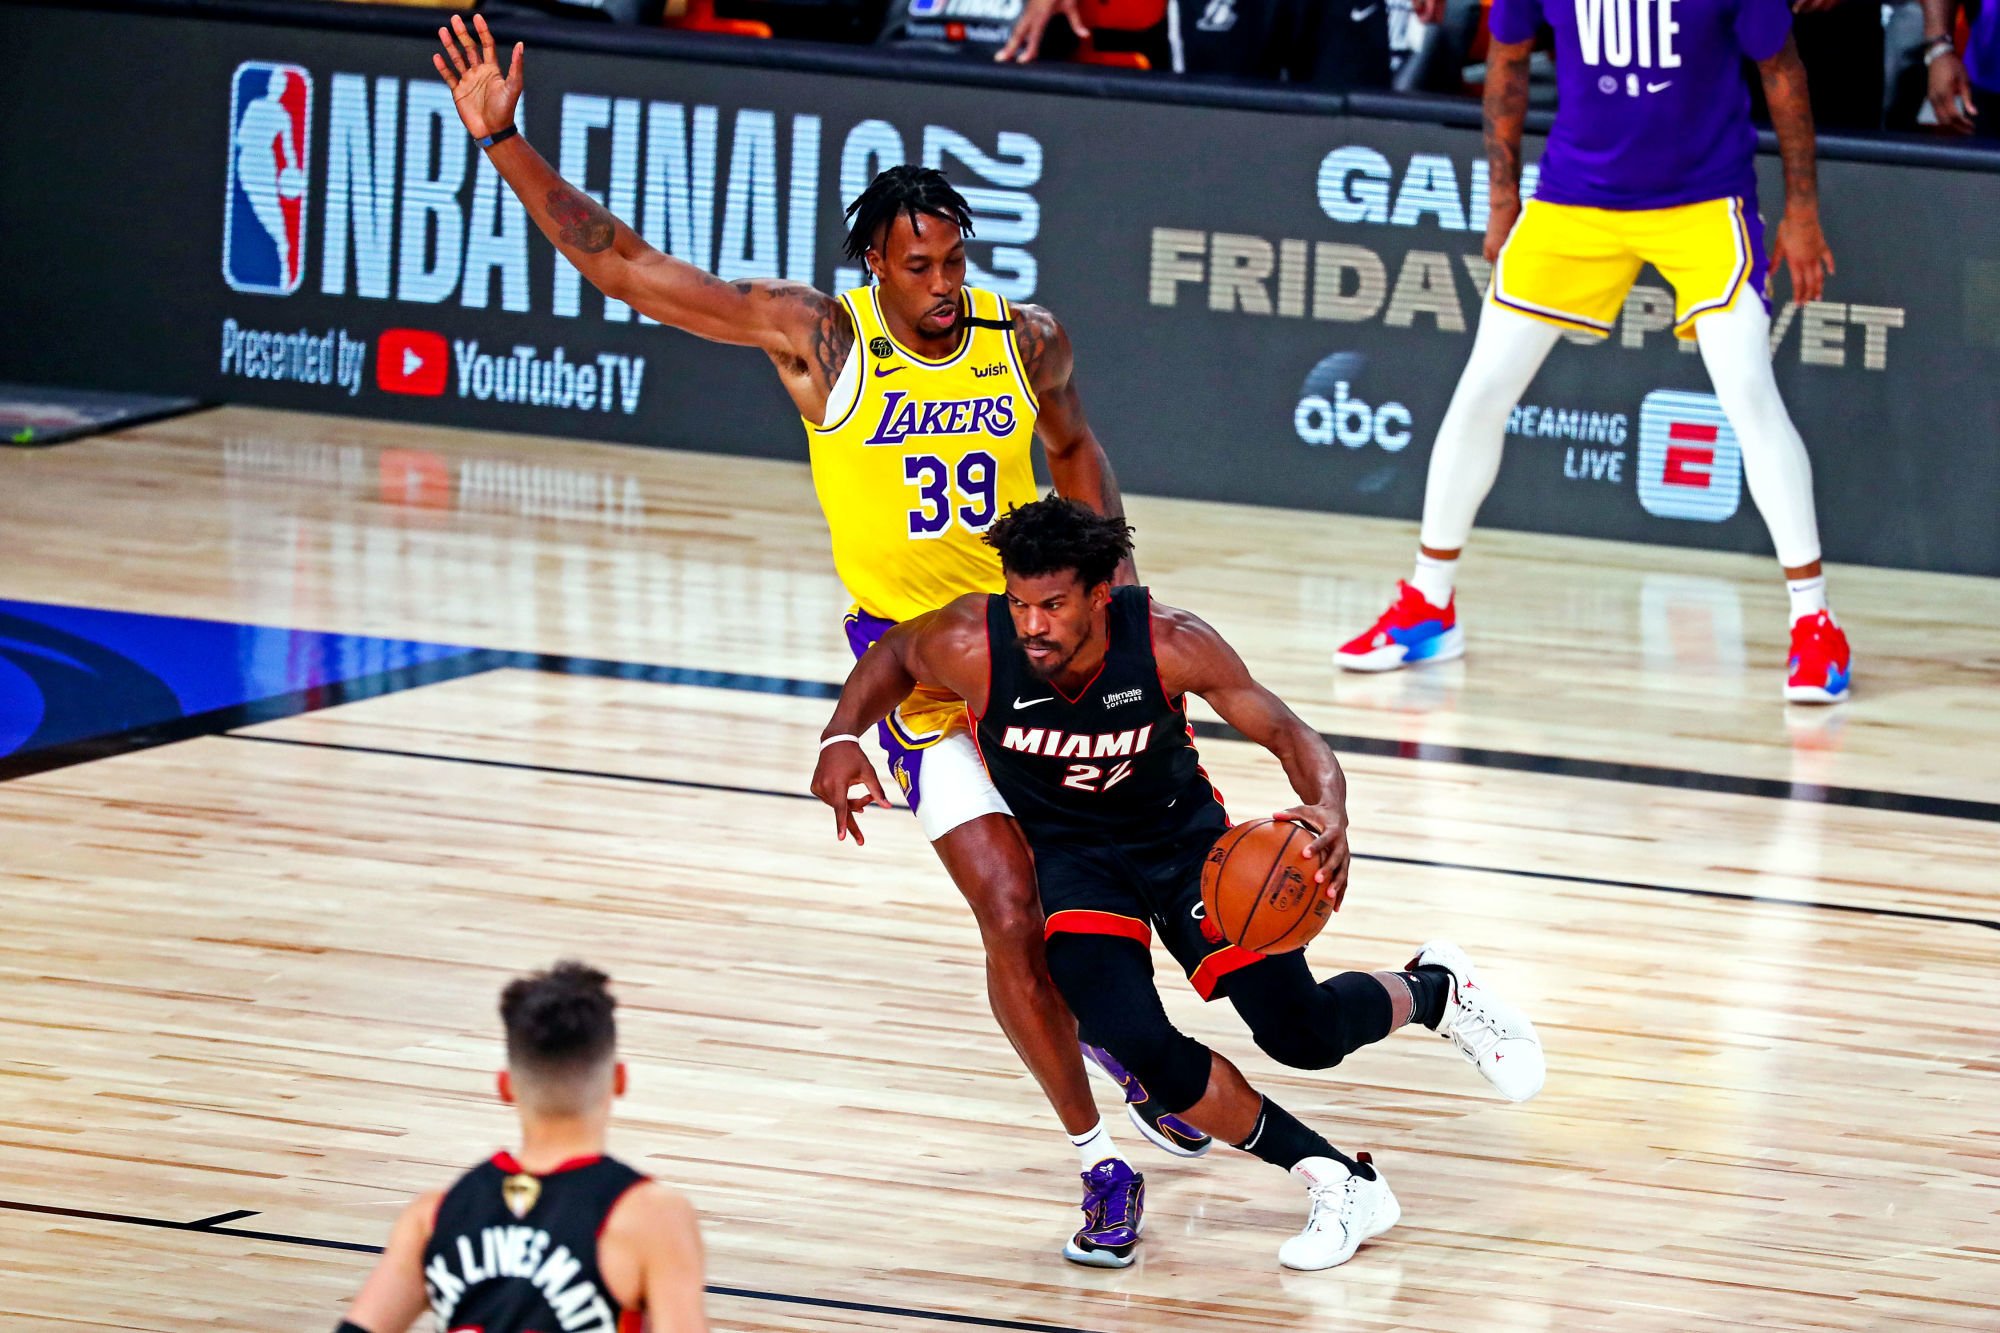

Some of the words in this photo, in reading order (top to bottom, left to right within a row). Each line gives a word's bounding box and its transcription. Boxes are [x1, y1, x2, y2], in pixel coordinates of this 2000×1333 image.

[1574, 0, 1682, 69] VOTE
[320, 72, 530, 313] NBA
[221, 318, 334, 383] Presented
[337, 328, 366, 397] by
[971, 362, 1008, 379] wish
[864, 390, 1017, 446] LAKERS
[1294, 380, 1413, 452] abc
[1506, 405, 1628, 446] REAMING
[1563, 446, 1626, 483] LIVE
[903, 450, 999, 540] 39
[1102, 688, 1142, 704] Ultimate
[1106, 695, 1142, 710] SOFTWARE
[1001, 723, 1153, 758] MIAMI
[1062, 759, 1133, 792] 22
[456, 1225, 551, 1285] LIVES
